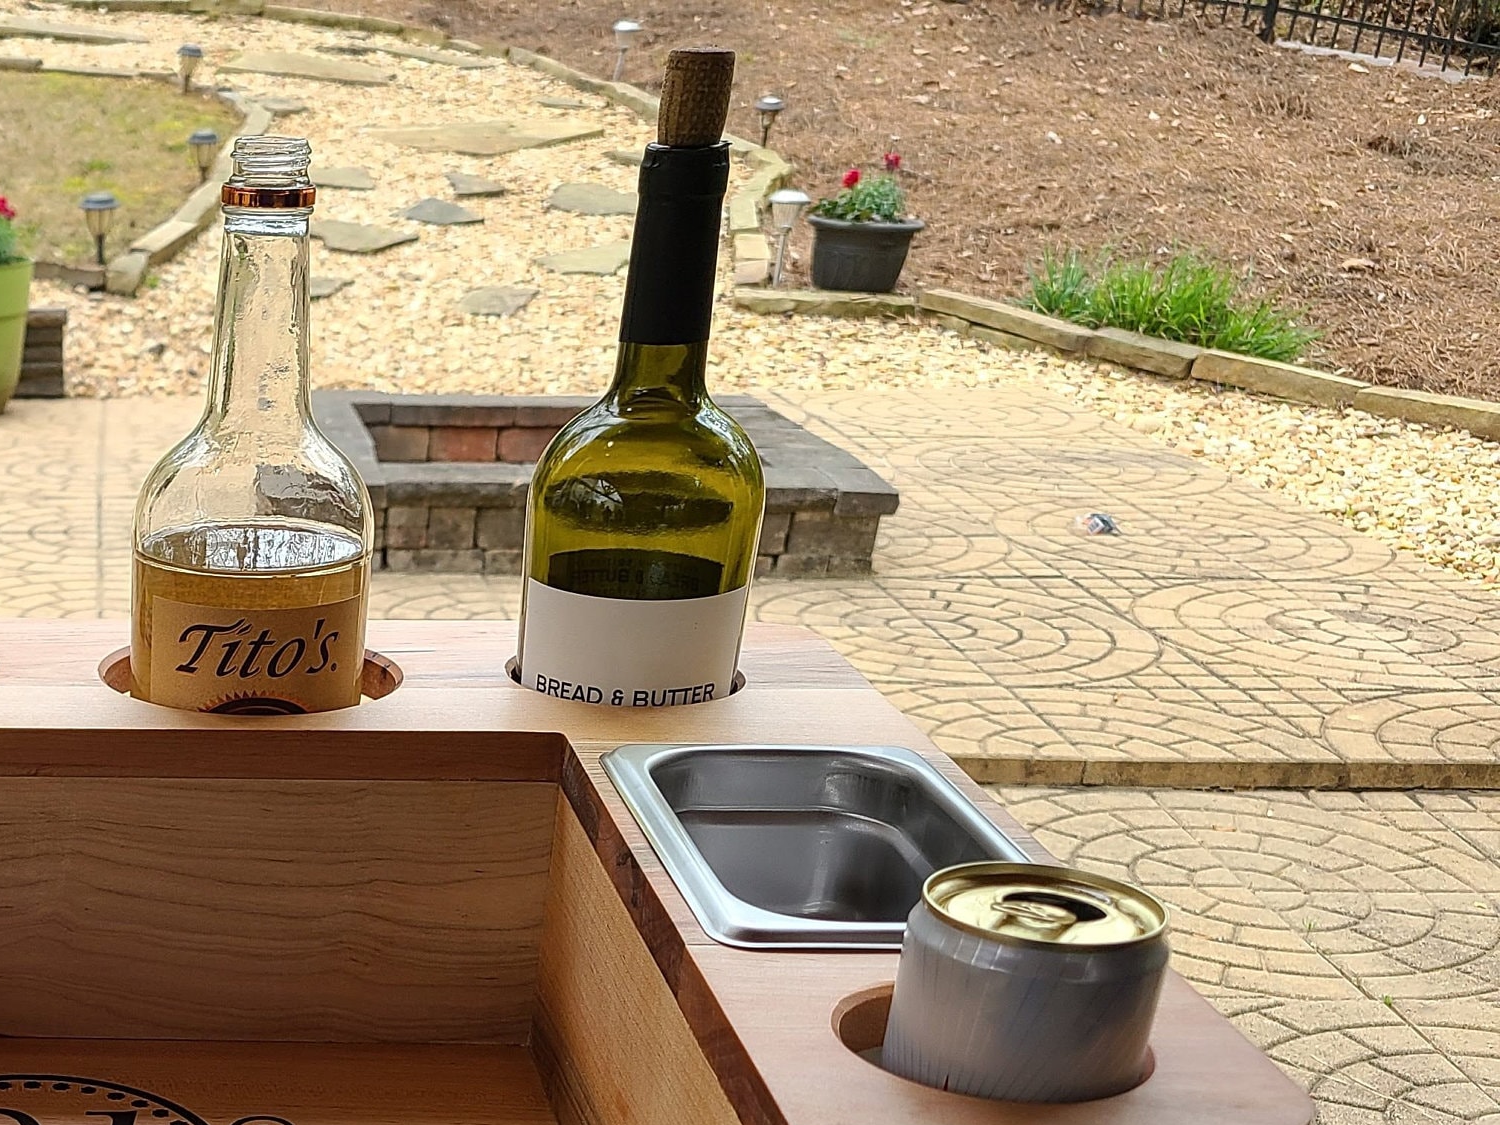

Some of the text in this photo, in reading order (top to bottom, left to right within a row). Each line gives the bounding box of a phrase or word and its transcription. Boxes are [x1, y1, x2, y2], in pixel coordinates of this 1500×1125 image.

[175, 618, 339, 679] Tito's
[536, 673, 716, 708] BREAD & BUTTER
